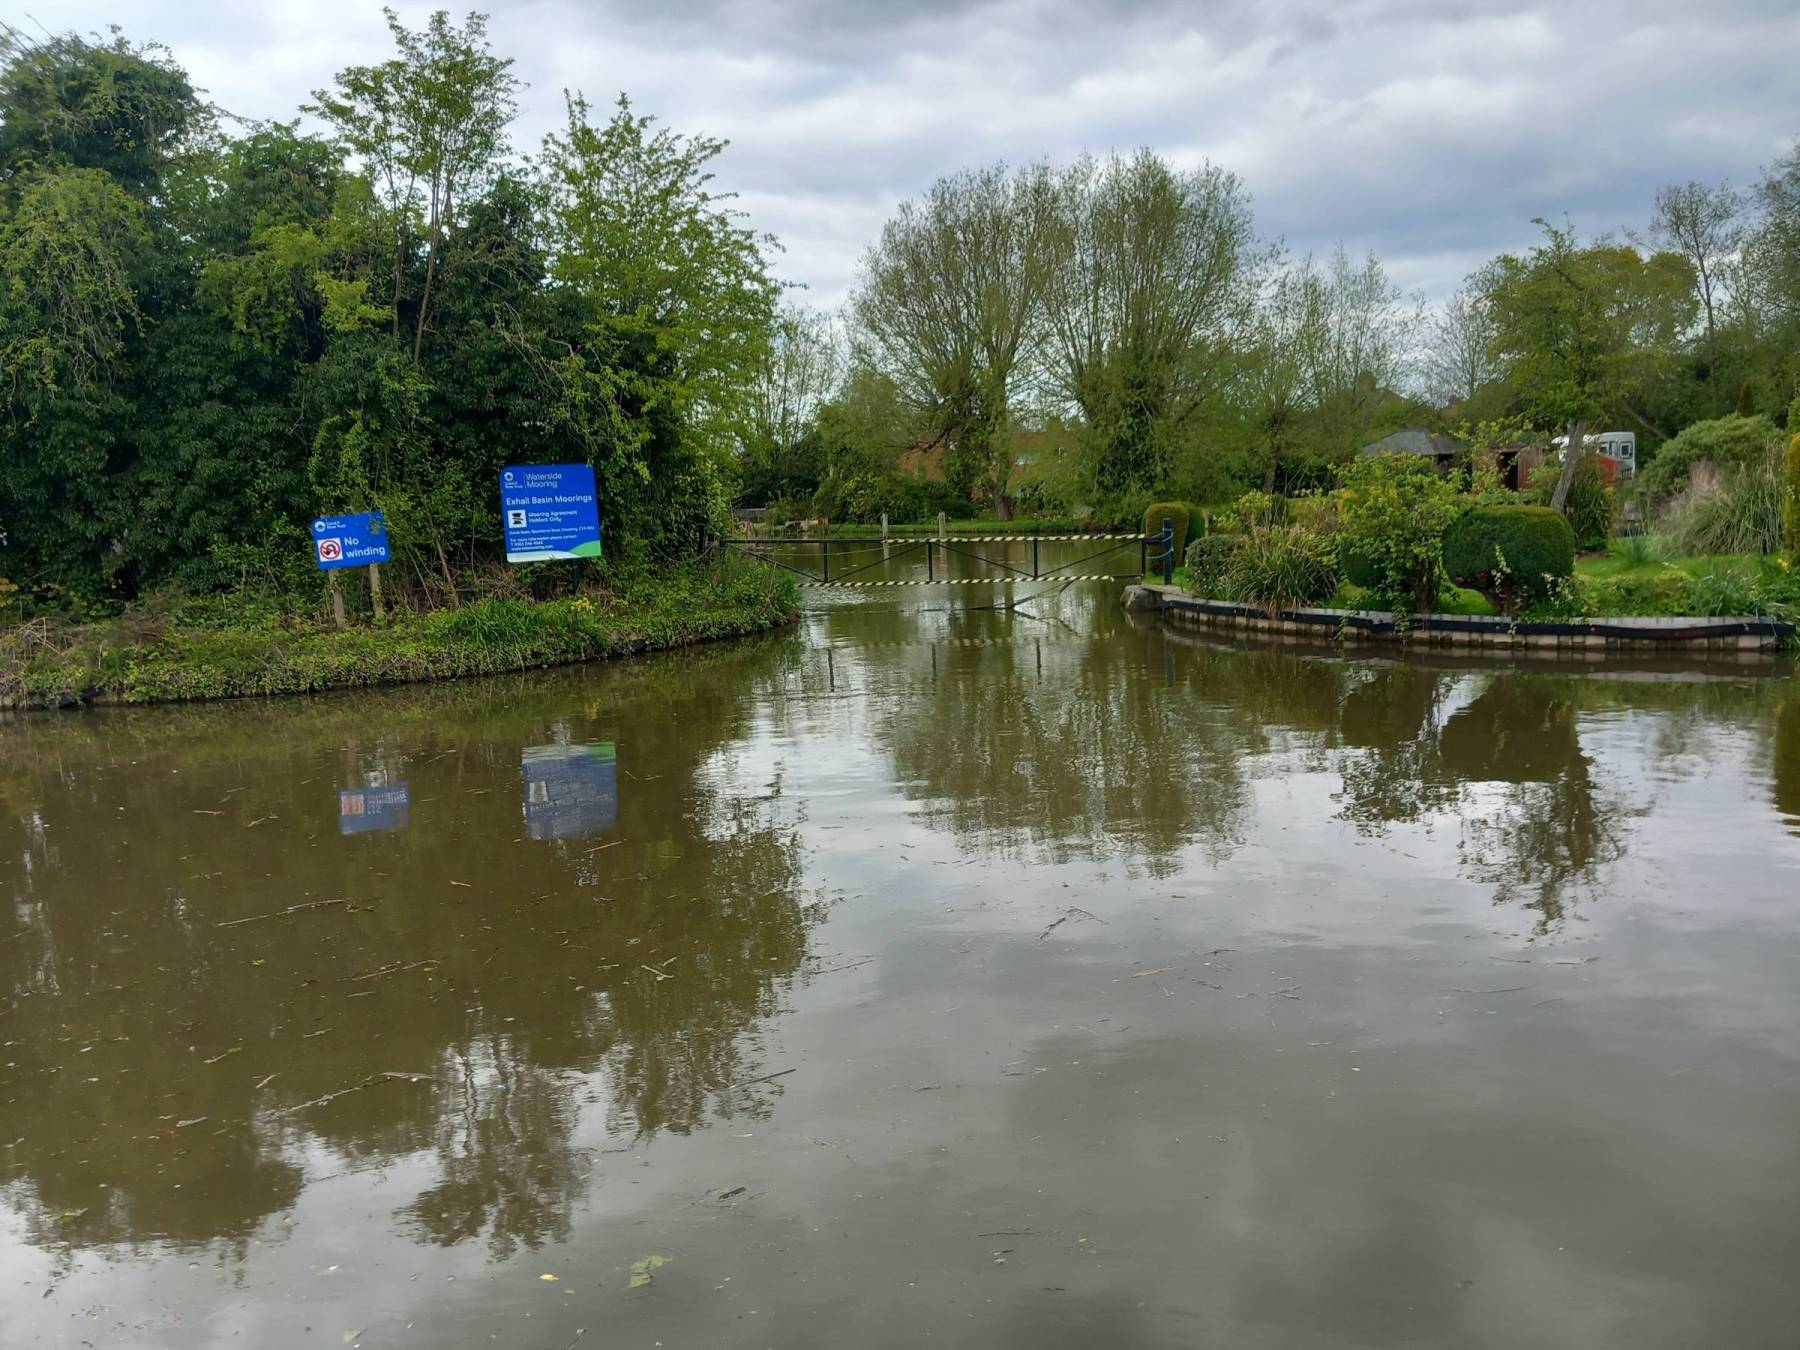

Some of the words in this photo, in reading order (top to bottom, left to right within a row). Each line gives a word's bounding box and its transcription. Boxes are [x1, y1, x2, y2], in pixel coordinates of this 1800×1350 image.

[525, 472, 562, 481] Waterside
[527, 480, 558, 489] Mooring
[506, 496, 530, 505] Exhall
[532, 495, 553, 504] Basin
[555, 494, 592, 503] Moorings
[344, 537, 359, 546] No
[346, 547, 385, 558] winding
